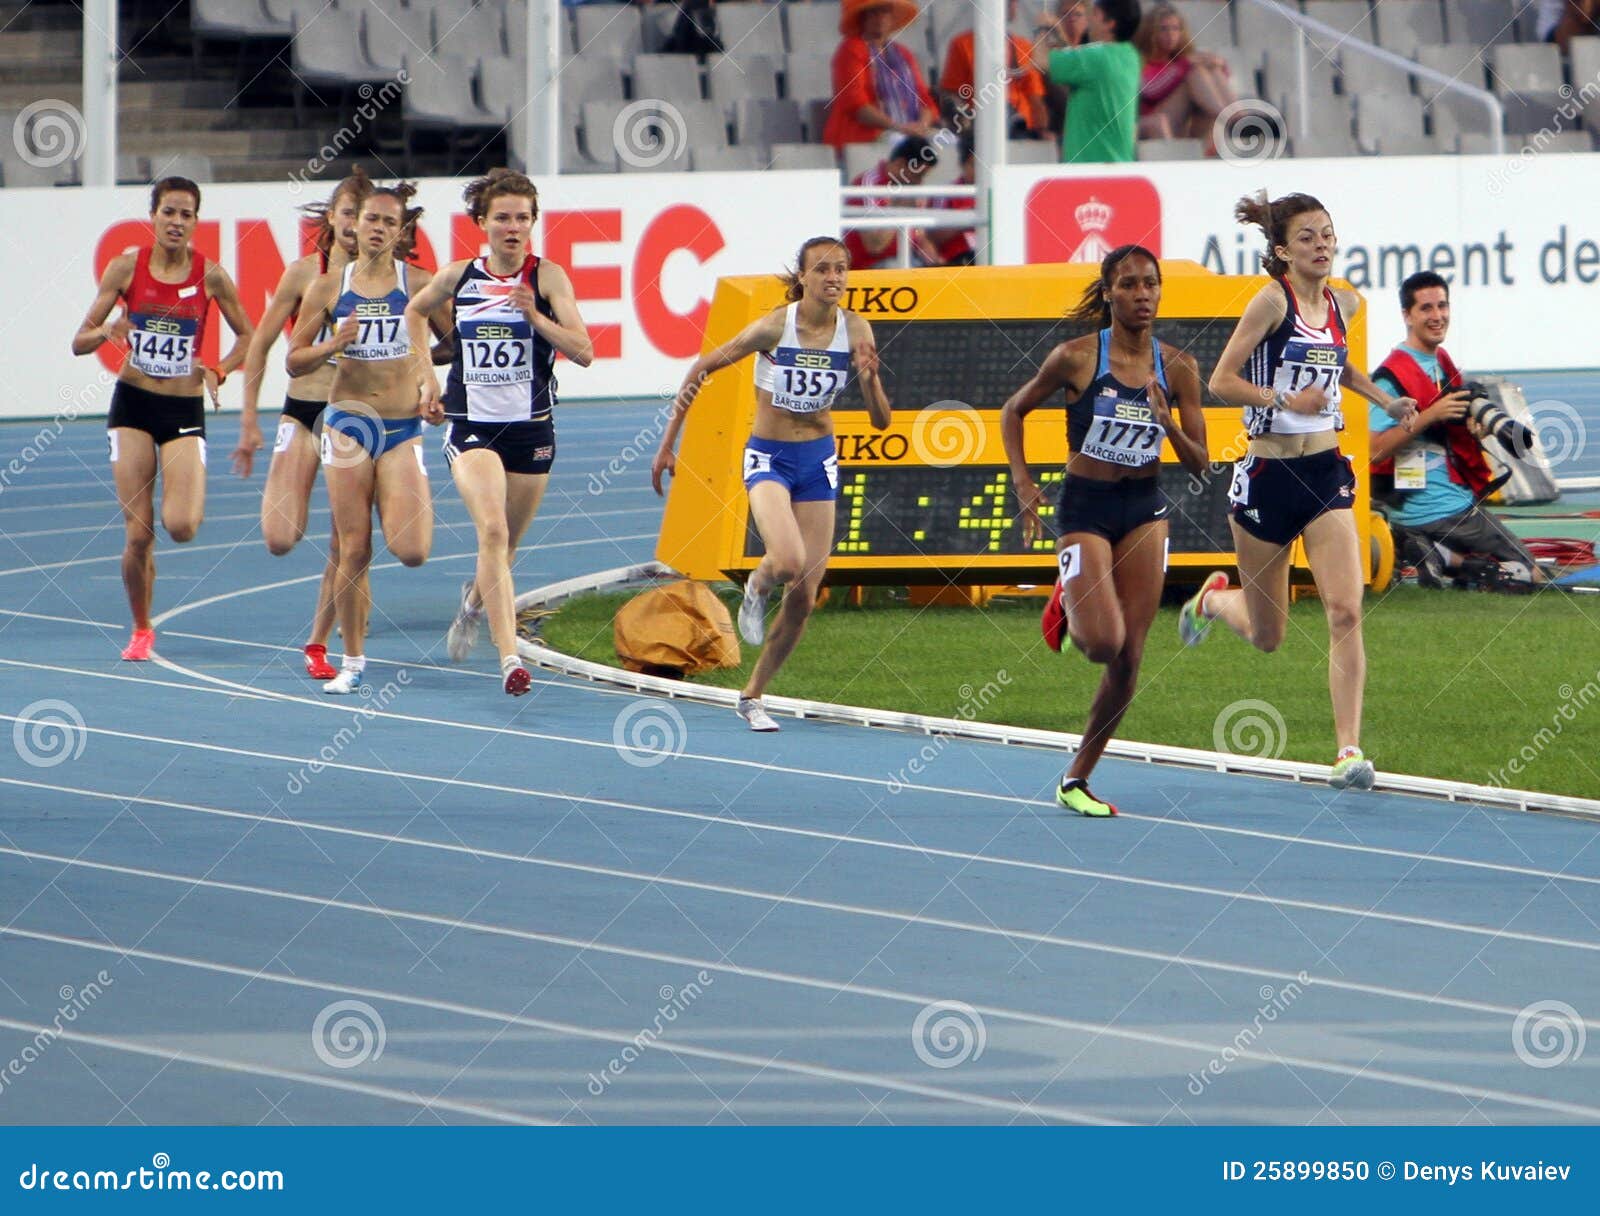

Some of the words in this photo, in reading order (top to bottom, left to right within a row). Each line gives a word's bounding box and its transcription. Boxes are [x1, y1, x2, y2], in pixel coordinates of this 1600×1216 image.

[1201, 229, 1514, 291] Ajament
[1539, 225, 1600, 284] de
[94, 203, 725, 376] SINEC
[845, 286, 918, 313] IKO
[355, 304, 391, 316] SER
[145, 320, 181, 335] SER
[357, 318, 401, 344] 717
[476, 326, 513, 339] SER
[133, 333, 189, 361] 1445
[467, 341, 527, 368] 1262
[1305, 349, 1338, 365] SER
[794, 353, 831, 369] SER
[465, 371, 511, 383] BARCELONA
[515, 370, 531, 381] 2012
[783, 369, 838, 397] 1352
[774, 393, 820, 409] BARCELONA
[1115, 404, 1152, 422] SER
[1099, 420, 1160, 449] 1773
[836, 434, 908, 460] IKO
[1084, 443, 1136, 465] BARCELONA
[1140, 454, 1158, 465] 201
[1233, 473, 1242, 497] 6
[1060, 552, 1072, 575] 9
